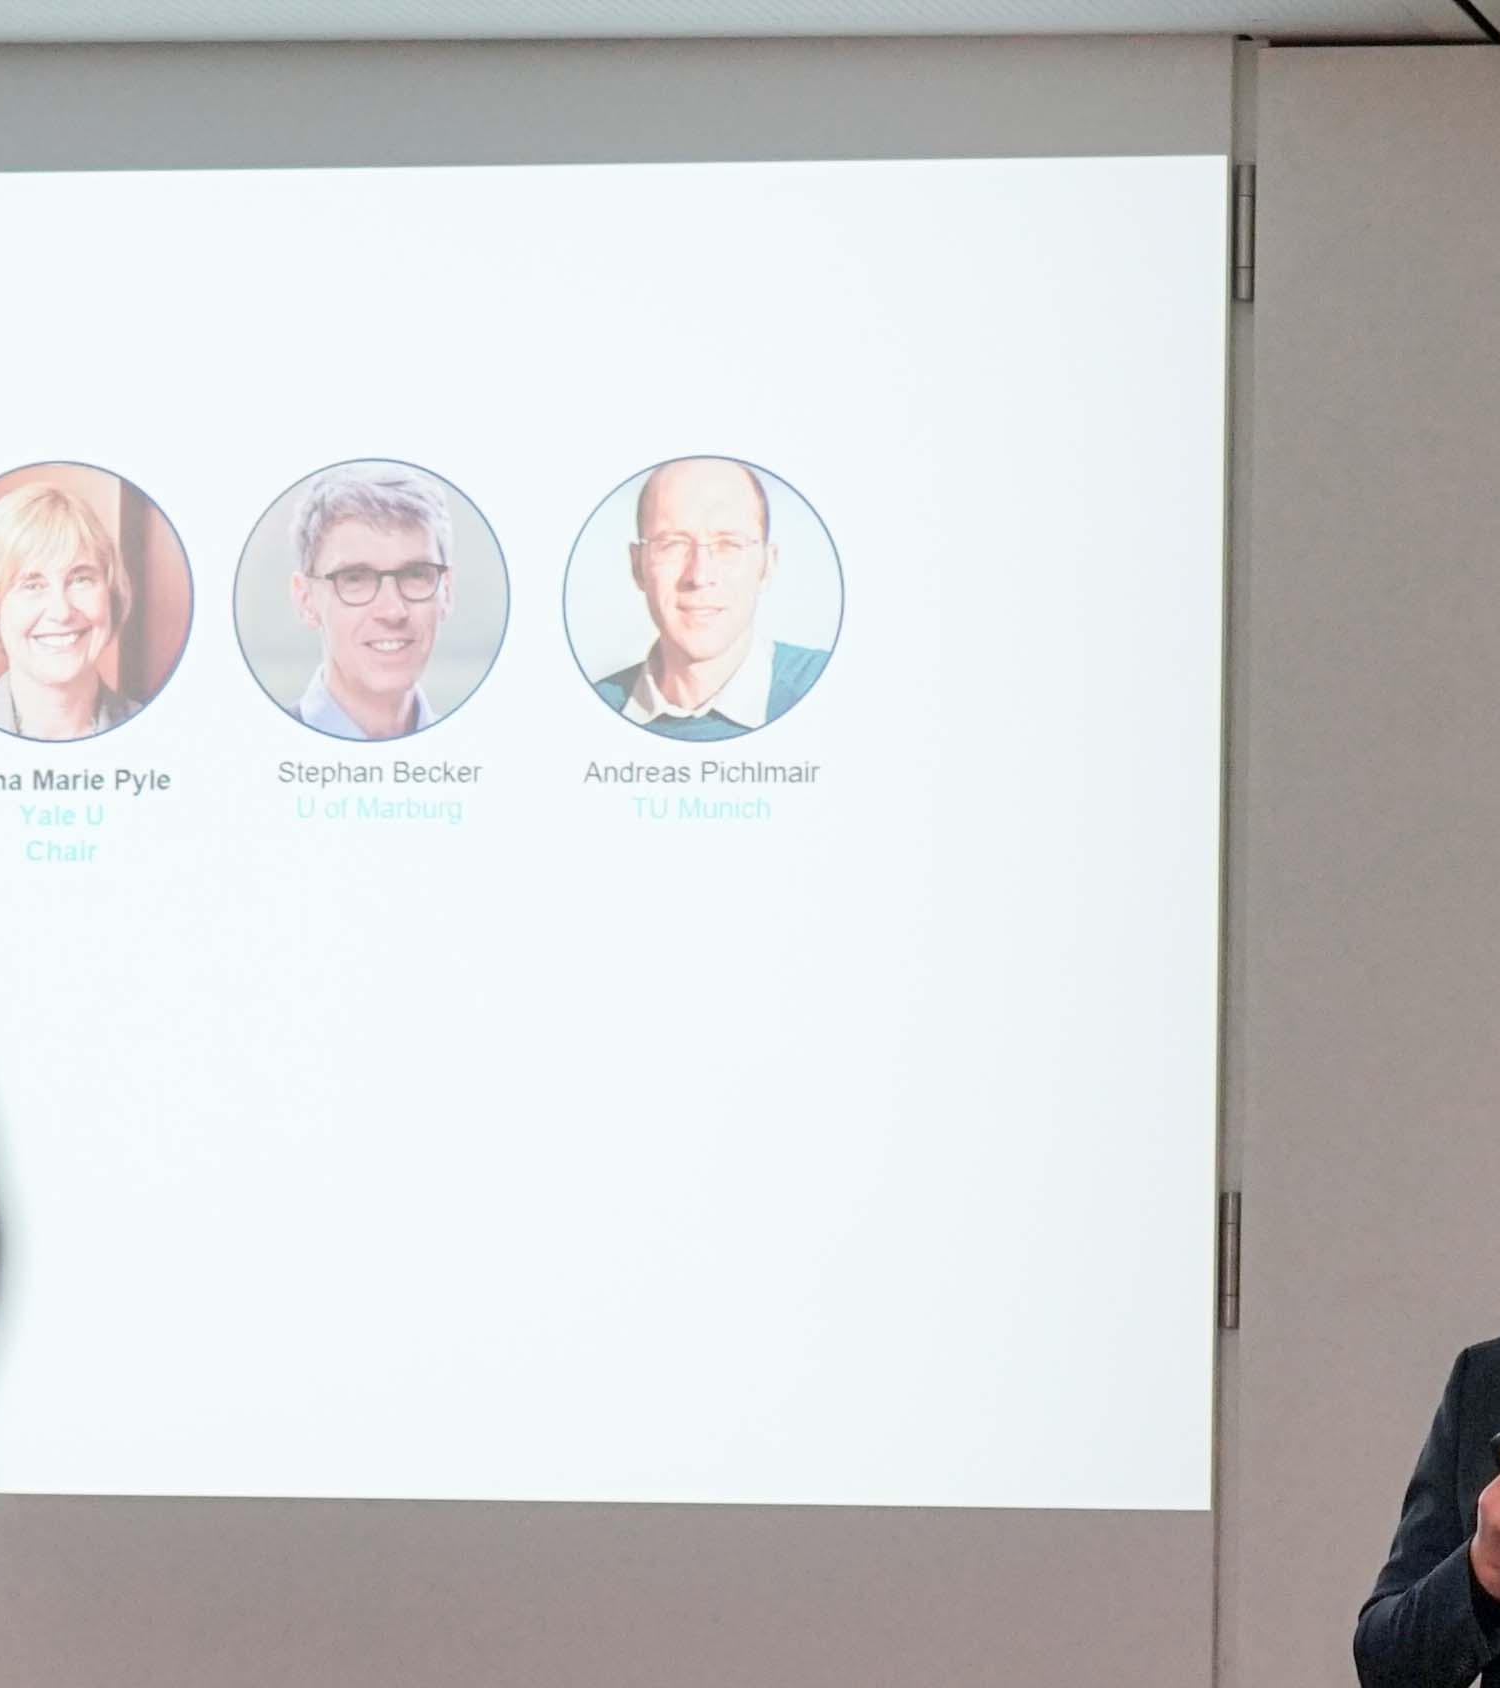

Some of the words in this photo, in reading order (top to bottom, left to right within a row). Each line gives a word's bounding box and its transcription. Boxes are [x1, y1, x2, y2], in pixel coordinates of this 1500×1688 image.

[32, 768, 105, 791] Marie
[114, 768, 172, 797] Pyle
[277, 760, 383, 789] Stephan
[392, 760, 483, 784] Becker
[583, 760, 691, 784] Andreas
[700, 760, 821, 784] Pichlmair
[19, 803, 77, 827] Yale
[85, 803, 105, 827] U
[296, 796, 316, 819] U
[324, 796, 348, 819] of
[356, 796, 464, 825] Marburg
[632, 796, 668, 820] TU
[677, 796, 772, 820] Munich
[24, 839, 100, 862] Chair
